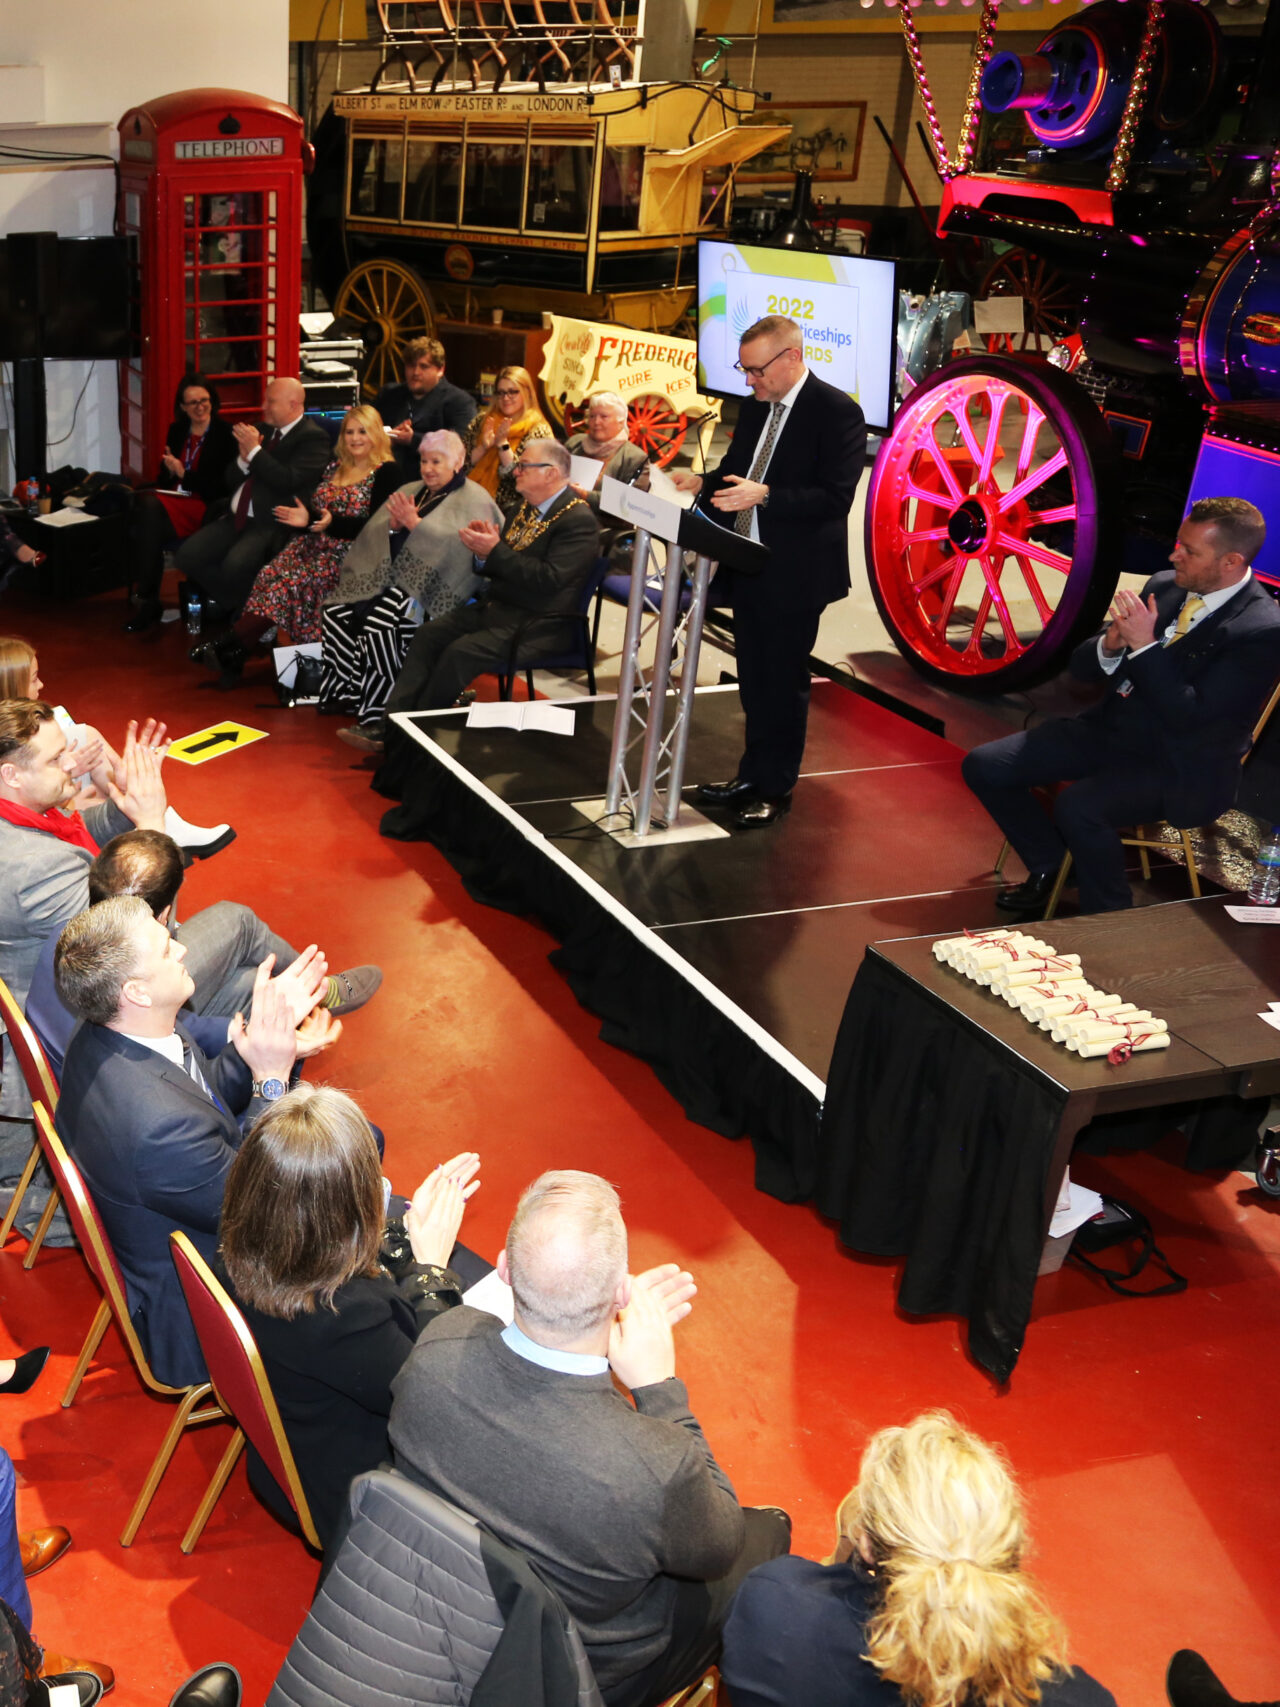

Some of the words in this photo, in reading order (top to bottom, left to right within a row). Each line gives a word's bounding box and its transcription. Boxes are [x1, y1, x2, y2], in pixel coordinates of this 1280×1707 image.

[335, 97, 368, 110] ALBERT
[400, 97, 418, 110] ELM
[421, 97, 441, 110] ROW
[455, 97, 493, 111] EASTER
[527, 98, 573, 111] LONDON
[182, 139, 279, 158] TELEPHONE
[497, 236, 534, 248] COMPANY
[541, 239, 577, 251] LIMITED
[766, 294, 815, 319] 2022
[587, 336, 697, 391] FREDERIC
[804, 345, 833, 364] RDS
[618, 369, 653, 390] PURE
[666, 377, 691, 394] ICES
